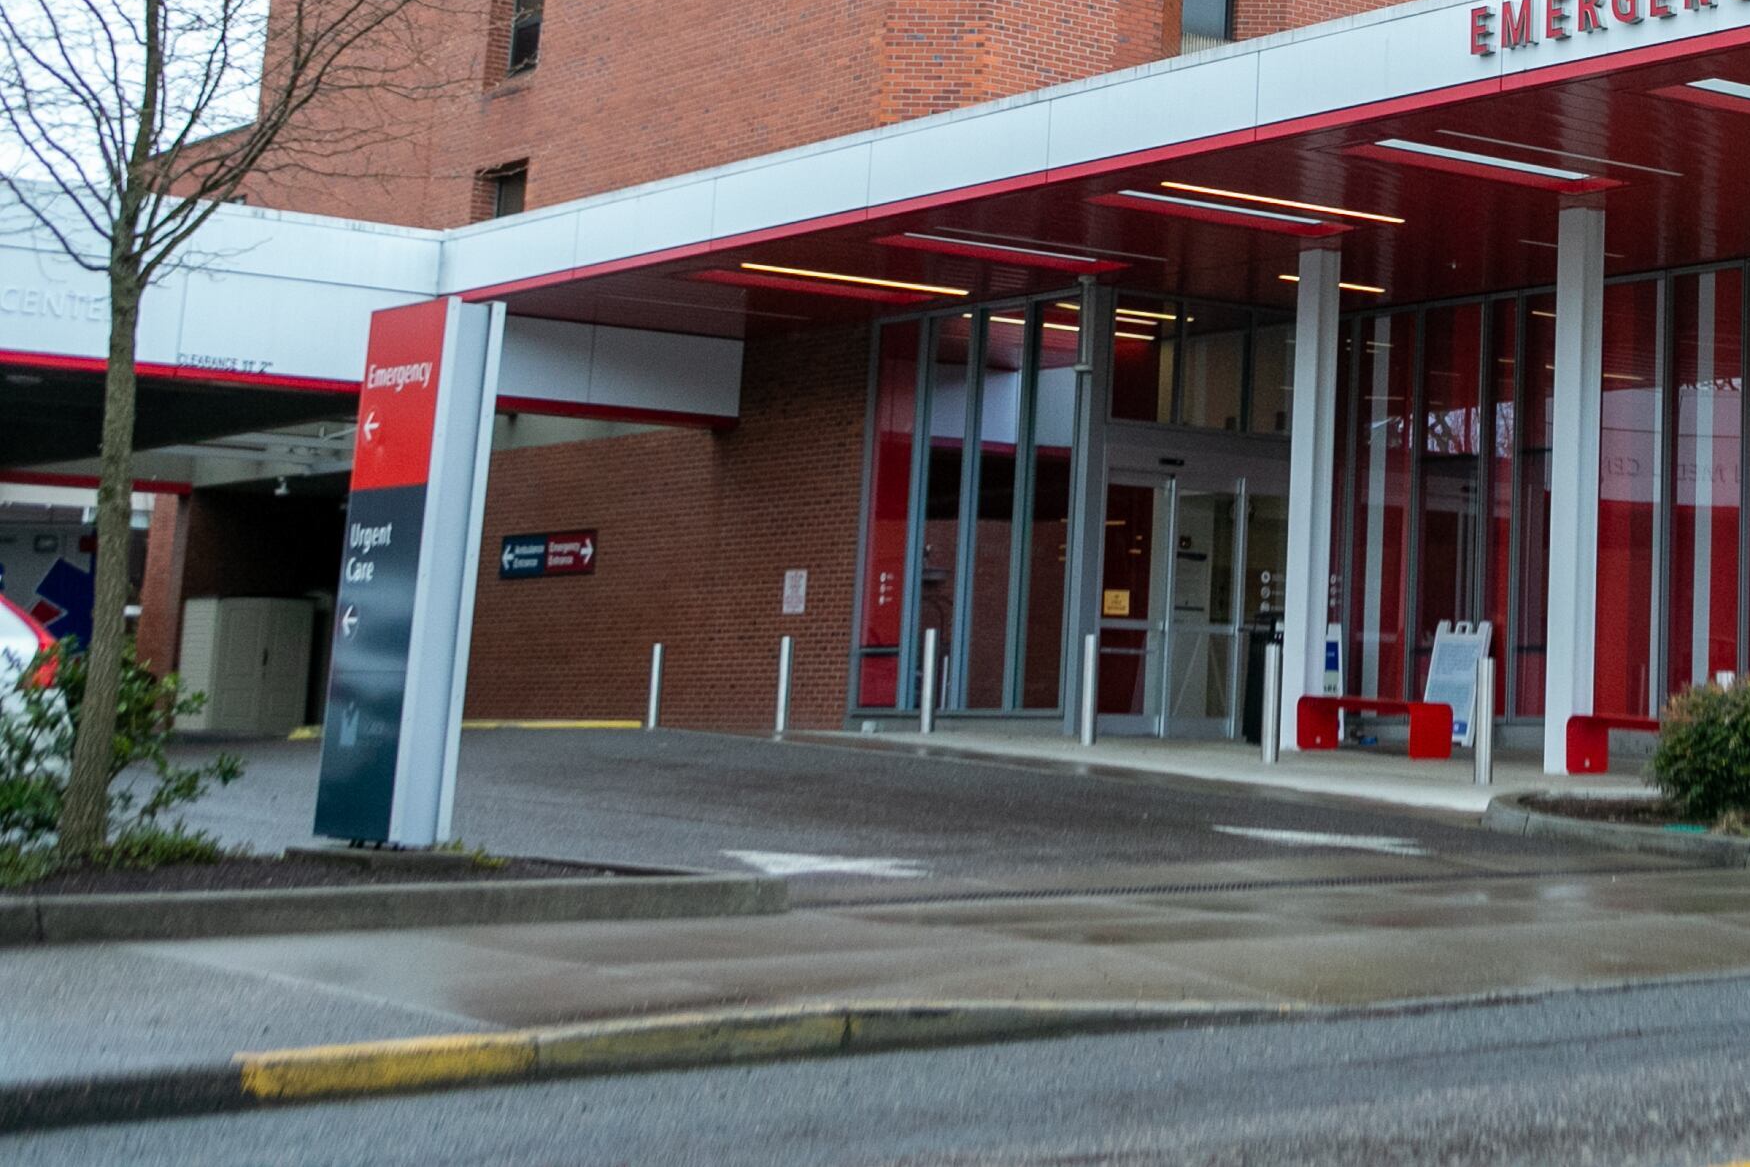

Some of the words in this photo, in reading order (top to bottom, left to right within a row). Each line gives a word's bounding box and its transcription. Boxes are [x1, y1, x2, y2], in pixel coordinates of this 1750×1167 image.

[0, 287, 111, 323] CENTE
[367, 361, 433, 392] Emergency
[350, 522, 392, 554] Urgent
[345, 556, 375, 583] Care
